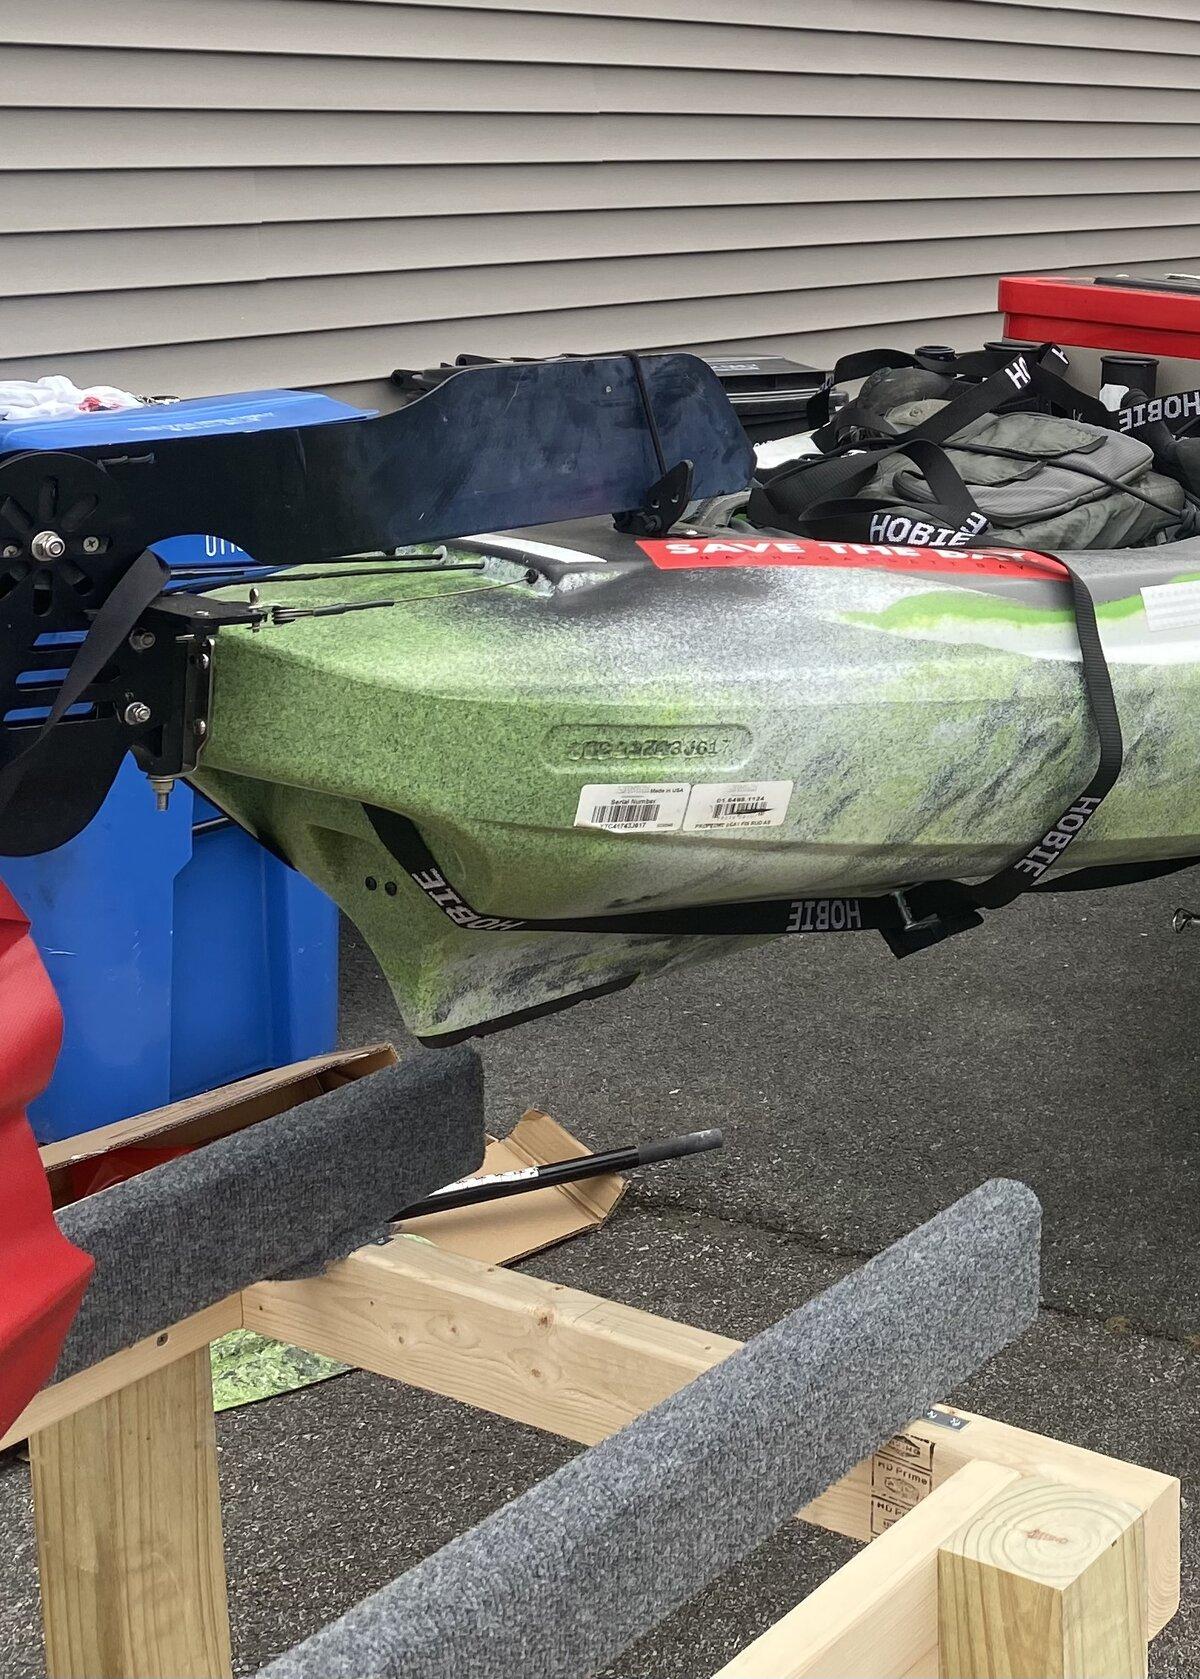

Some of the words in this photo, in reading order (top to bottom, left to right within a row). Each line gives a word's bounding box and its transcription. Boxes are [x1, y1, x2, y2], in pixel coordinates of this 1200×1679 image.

[869, 514, 976, 547] HOBIE
[665, 541, 806, 556] SAVE
[818, 542, 922, 558] THE
[1013, 796, 1102, 877] HOBIE
[411, 867, 527, 931] HOBIE
[785, 900, 862, 932] HOBIE
[895, 1467, 928, 1486] Prime
